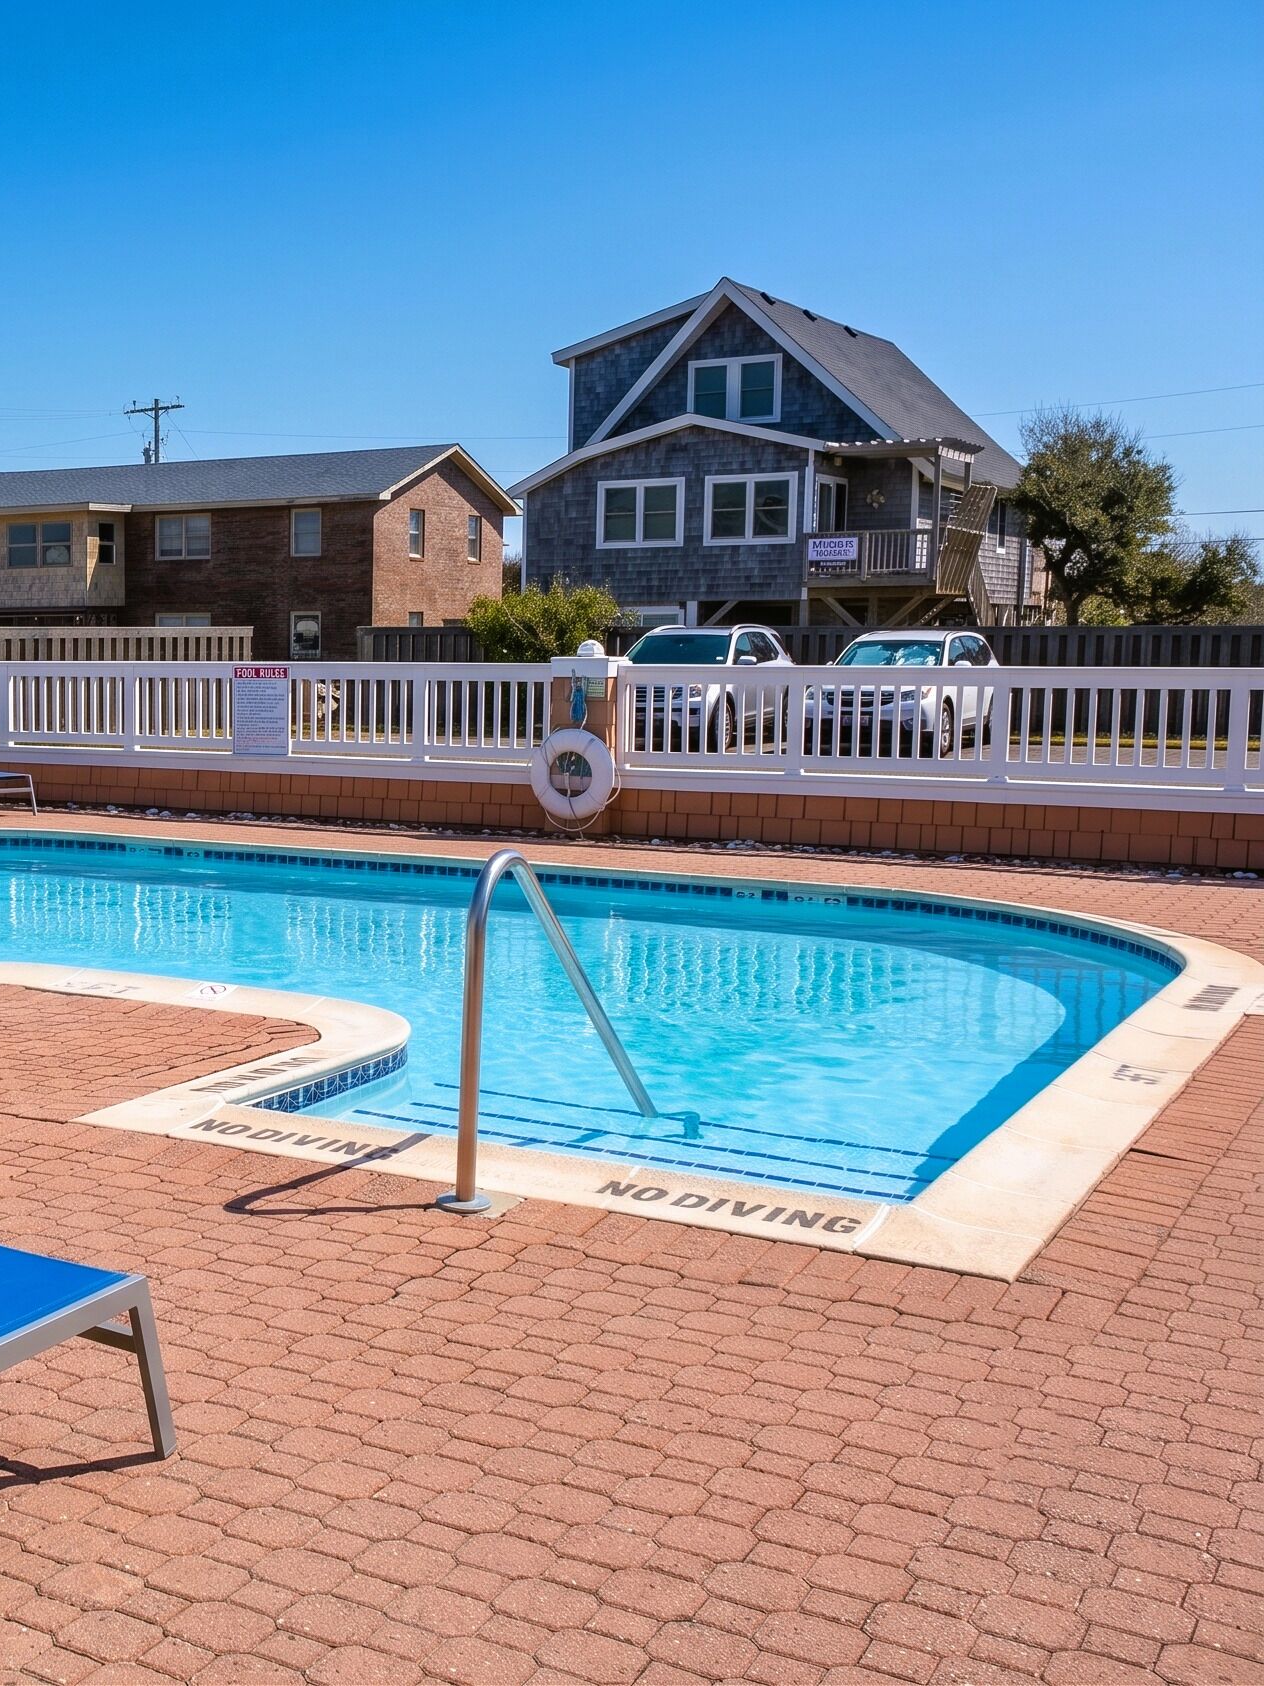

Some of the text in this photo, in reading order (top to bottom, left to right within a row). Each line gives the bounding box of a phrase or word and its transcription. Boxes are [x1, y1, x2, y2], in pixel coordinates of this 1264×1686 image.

[189, 1118, 252, 1136] NO
[595, 1180, 862, 1234] NO DIVING
